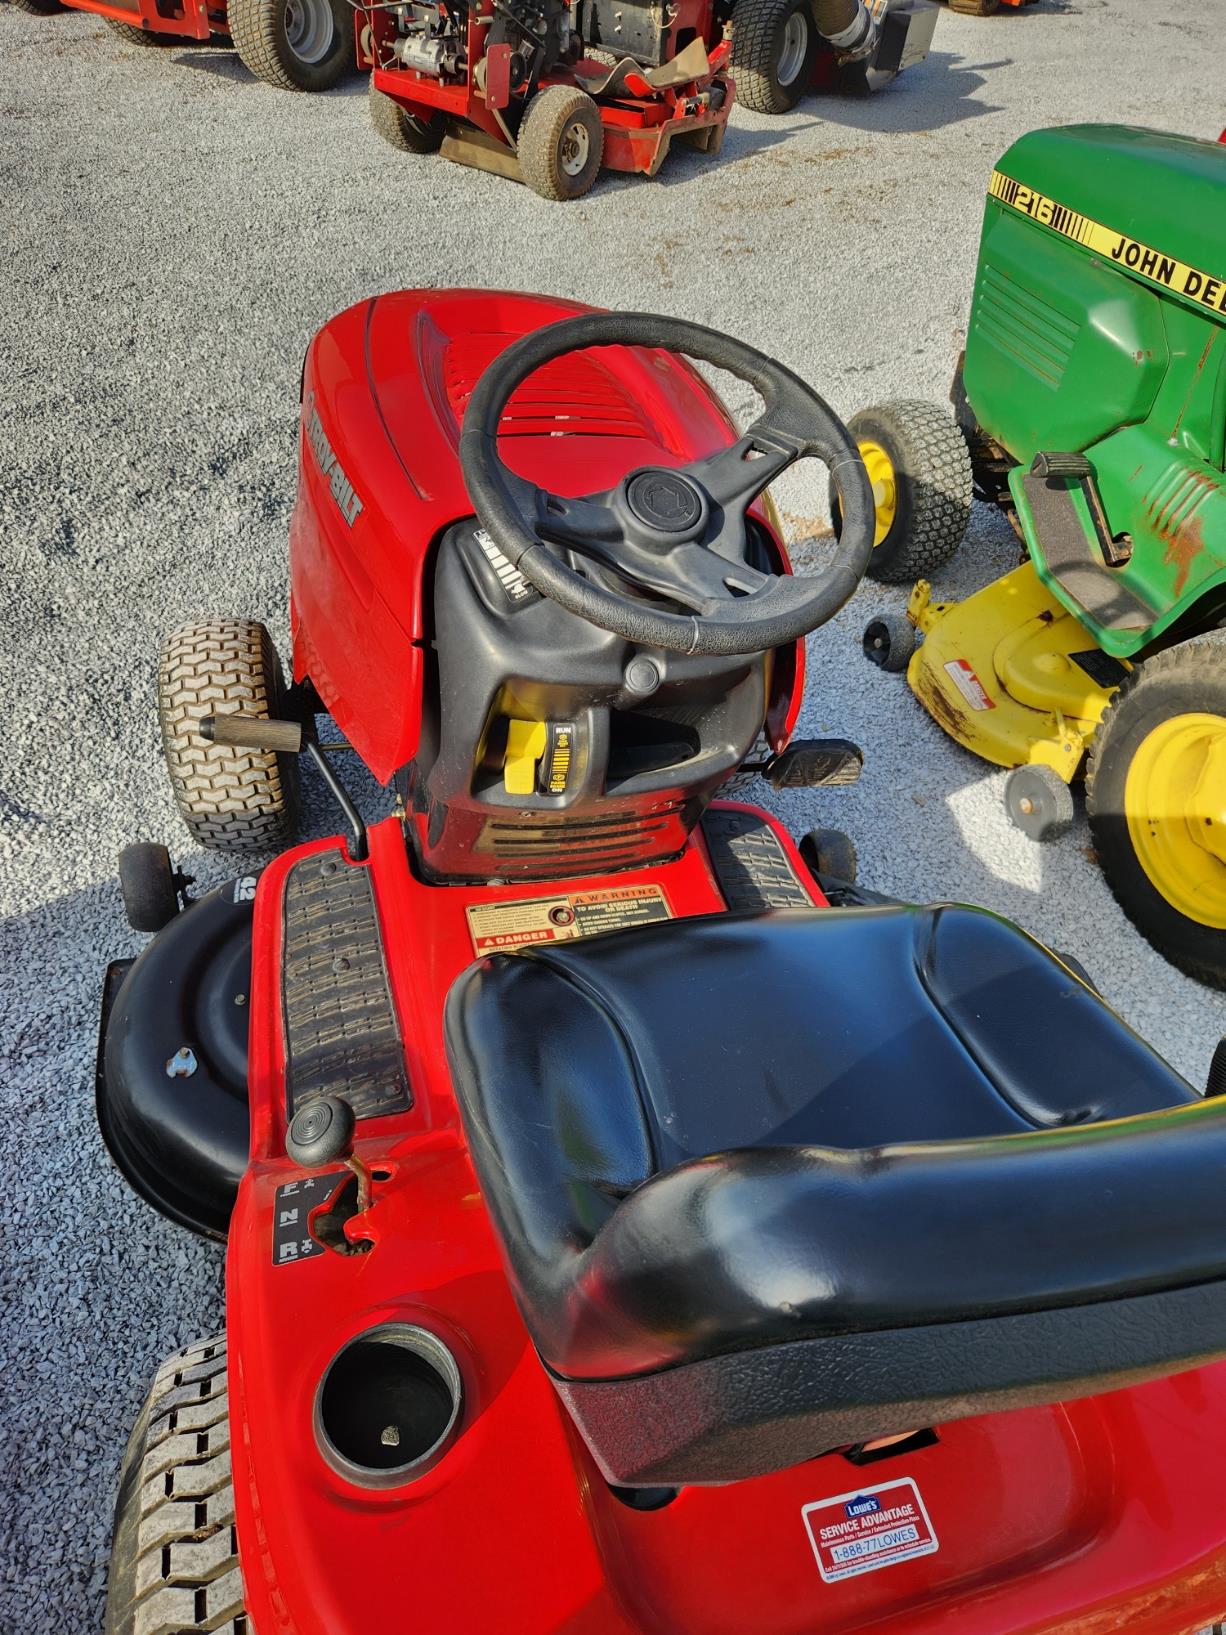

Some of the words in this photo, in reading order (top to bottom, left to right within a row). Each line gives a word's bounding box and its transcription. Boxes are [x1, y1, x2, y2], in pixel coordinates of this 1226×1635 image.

[1014, 186, 1055, 225] 216
[1111, 238, 1177, 285] JOHN
[589, 887, 657, 902] WARNING
[588, 903, 608, 911] AVOID
[608, 899, 637, 908] SERIOUS
[496, 931, 548, 944] DANGER
[283, 1182, 298, 1193] F
[280, 1208, 298, 1223] N
[280, 1241, 298, 1258] R
[820, 1519, 860, 1540] SERVICE
[861, 1503, 915, 1528] ADVANTAGE
[833, 1527, 917, 1560] 1-888-77LOWES
